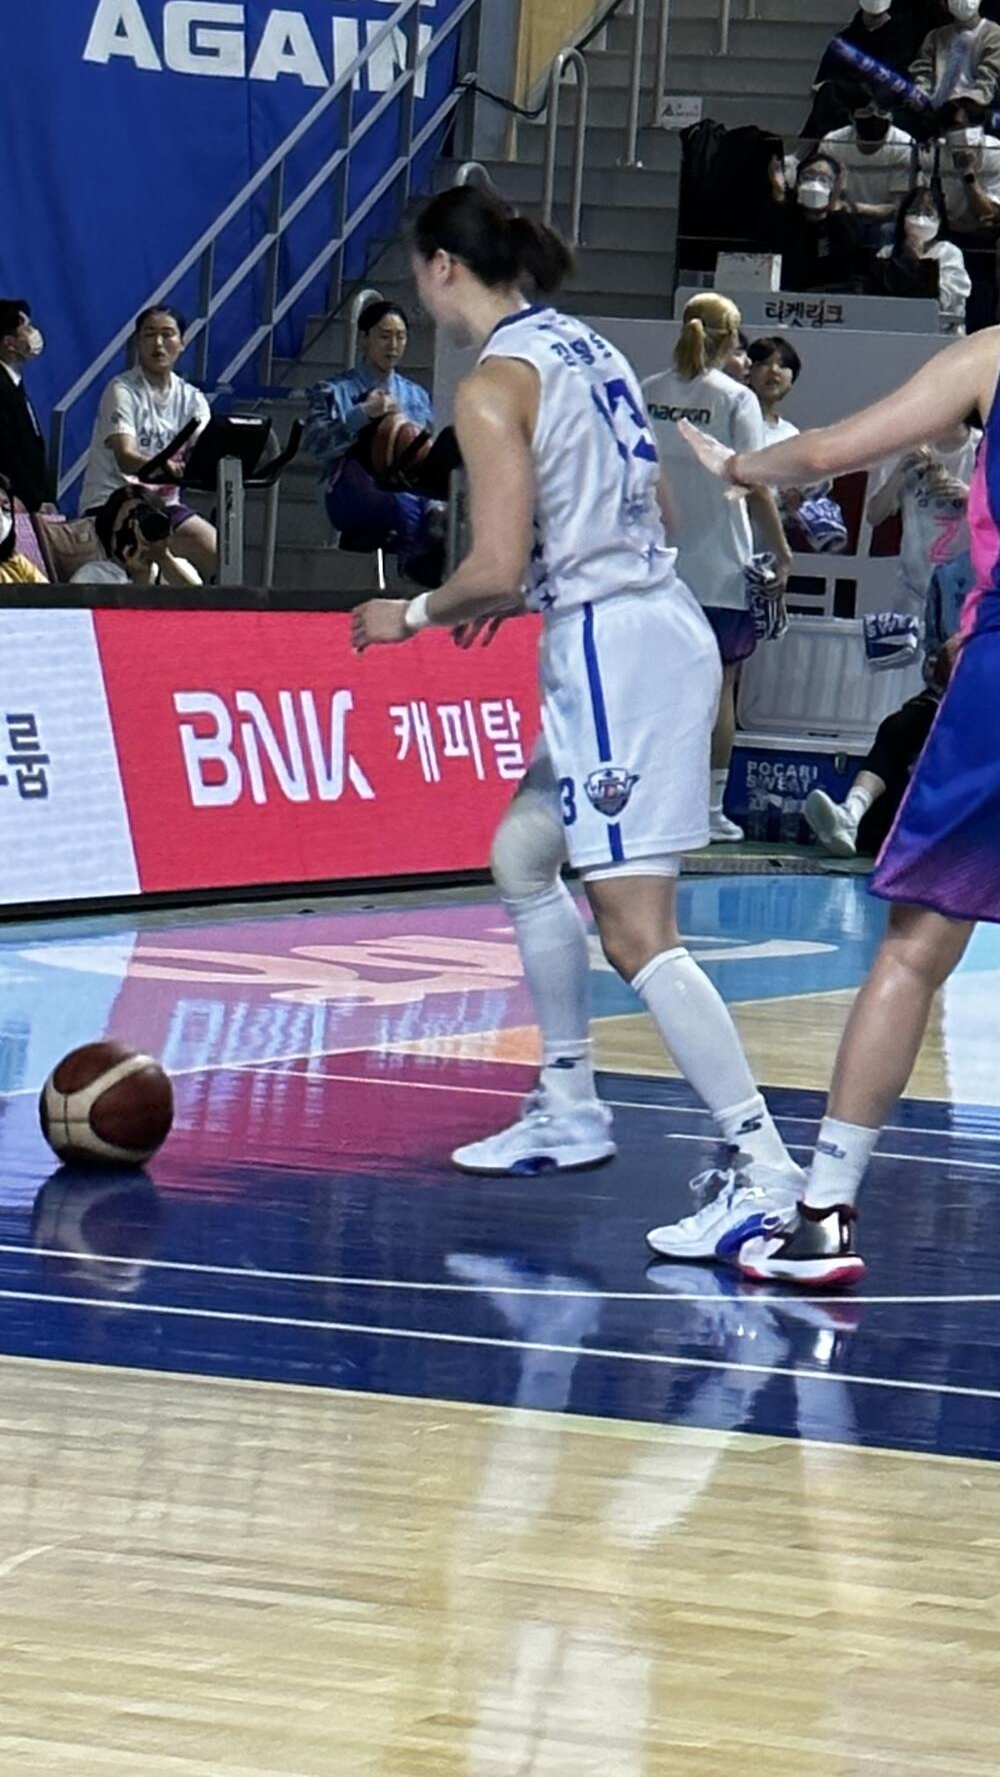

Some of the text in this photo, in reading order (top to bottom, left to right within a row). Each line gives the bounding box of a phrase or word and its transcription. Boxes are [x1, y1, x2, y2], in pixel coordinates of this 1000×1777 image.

[765, 299, 845, 328] 티켓링크
[0, 713, 50, 800] 룹
[172, 689, 527, 808] BNK 캐피탈
[746, 760, 818, 781] POCARI
